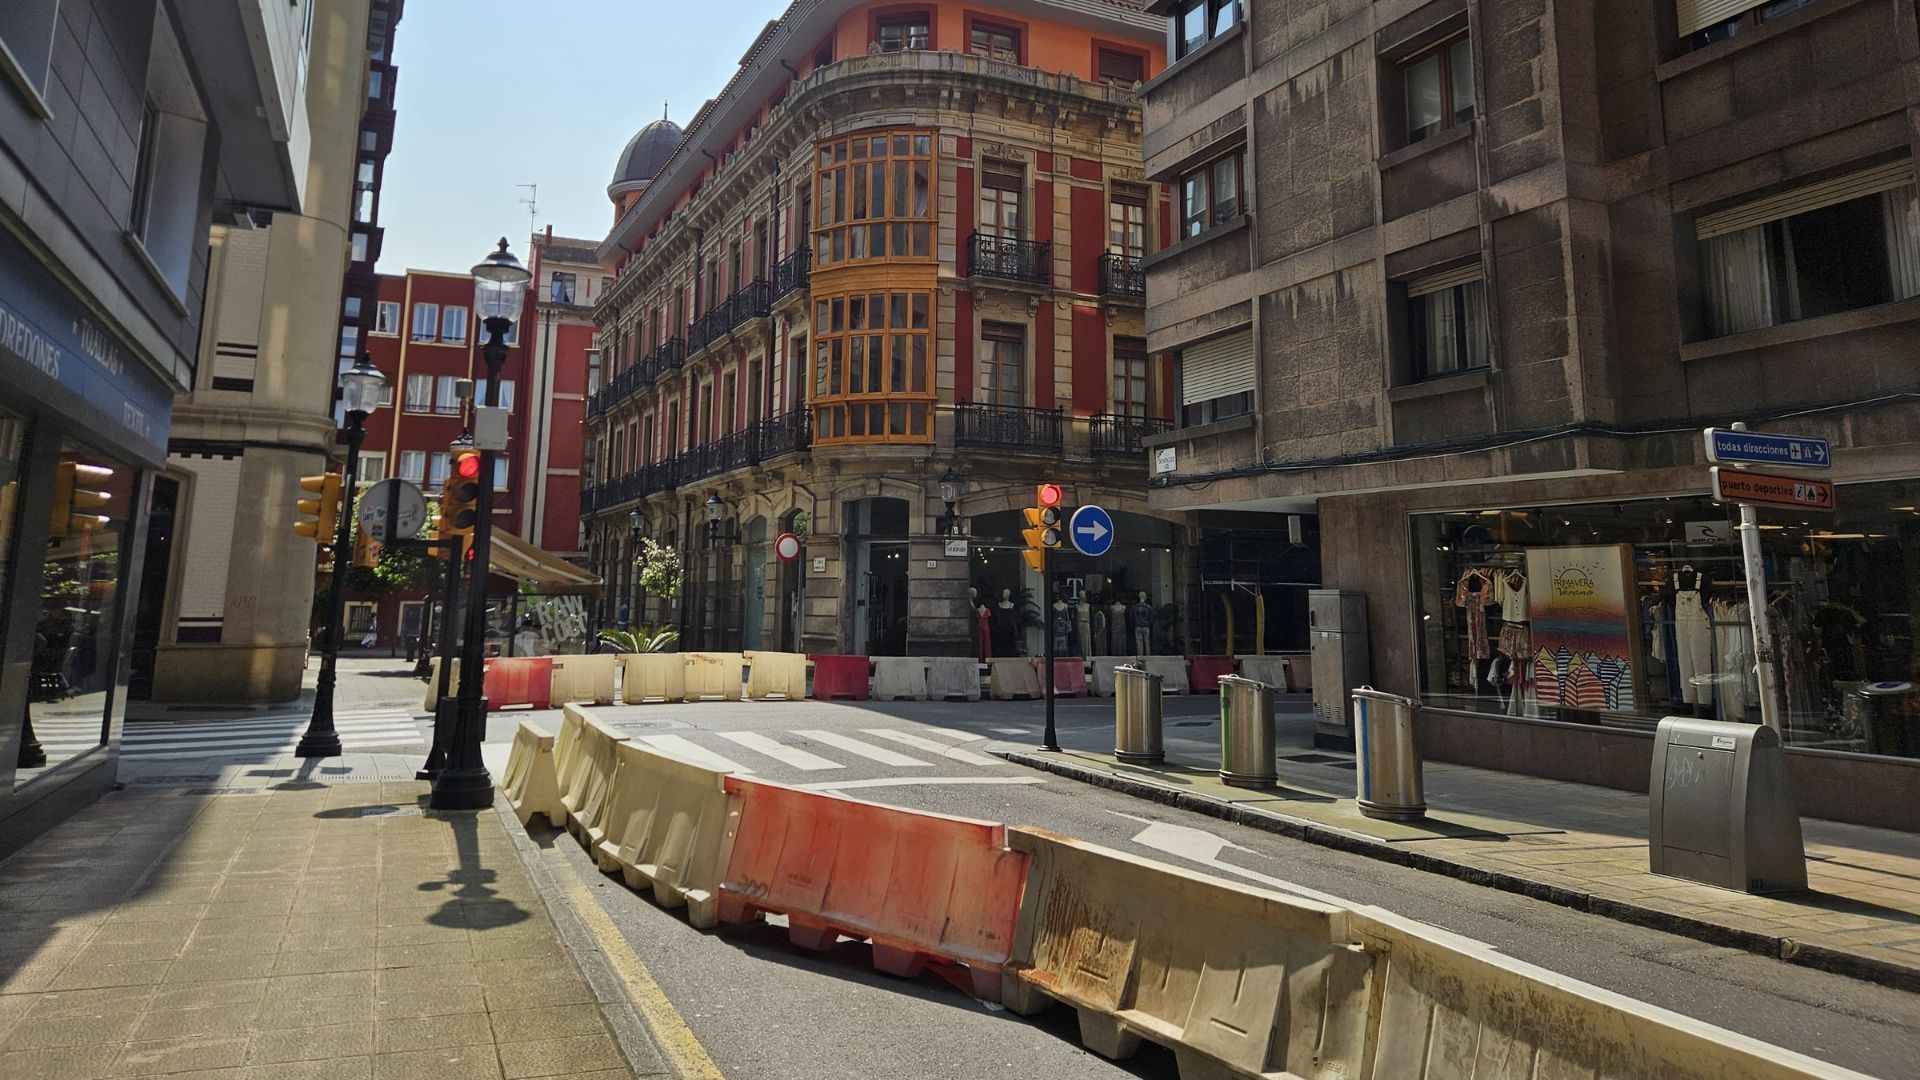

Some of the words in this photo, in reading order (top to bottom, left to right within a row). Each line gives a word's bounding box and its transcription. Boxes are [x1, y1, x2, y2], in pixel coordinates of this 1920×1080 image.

[1718, 441, 1741, 452] todas
[1743, 443, 1789, 456] direcciones
[1722, 483, 1751, 494] puerto
[1753, 483, 1794, 497] deportivo
[1553, 579, 1595, 588] PRIMAVERA
[1556, 588, 1594, 596] Verano
[536, 595, 584, 627] RAW
